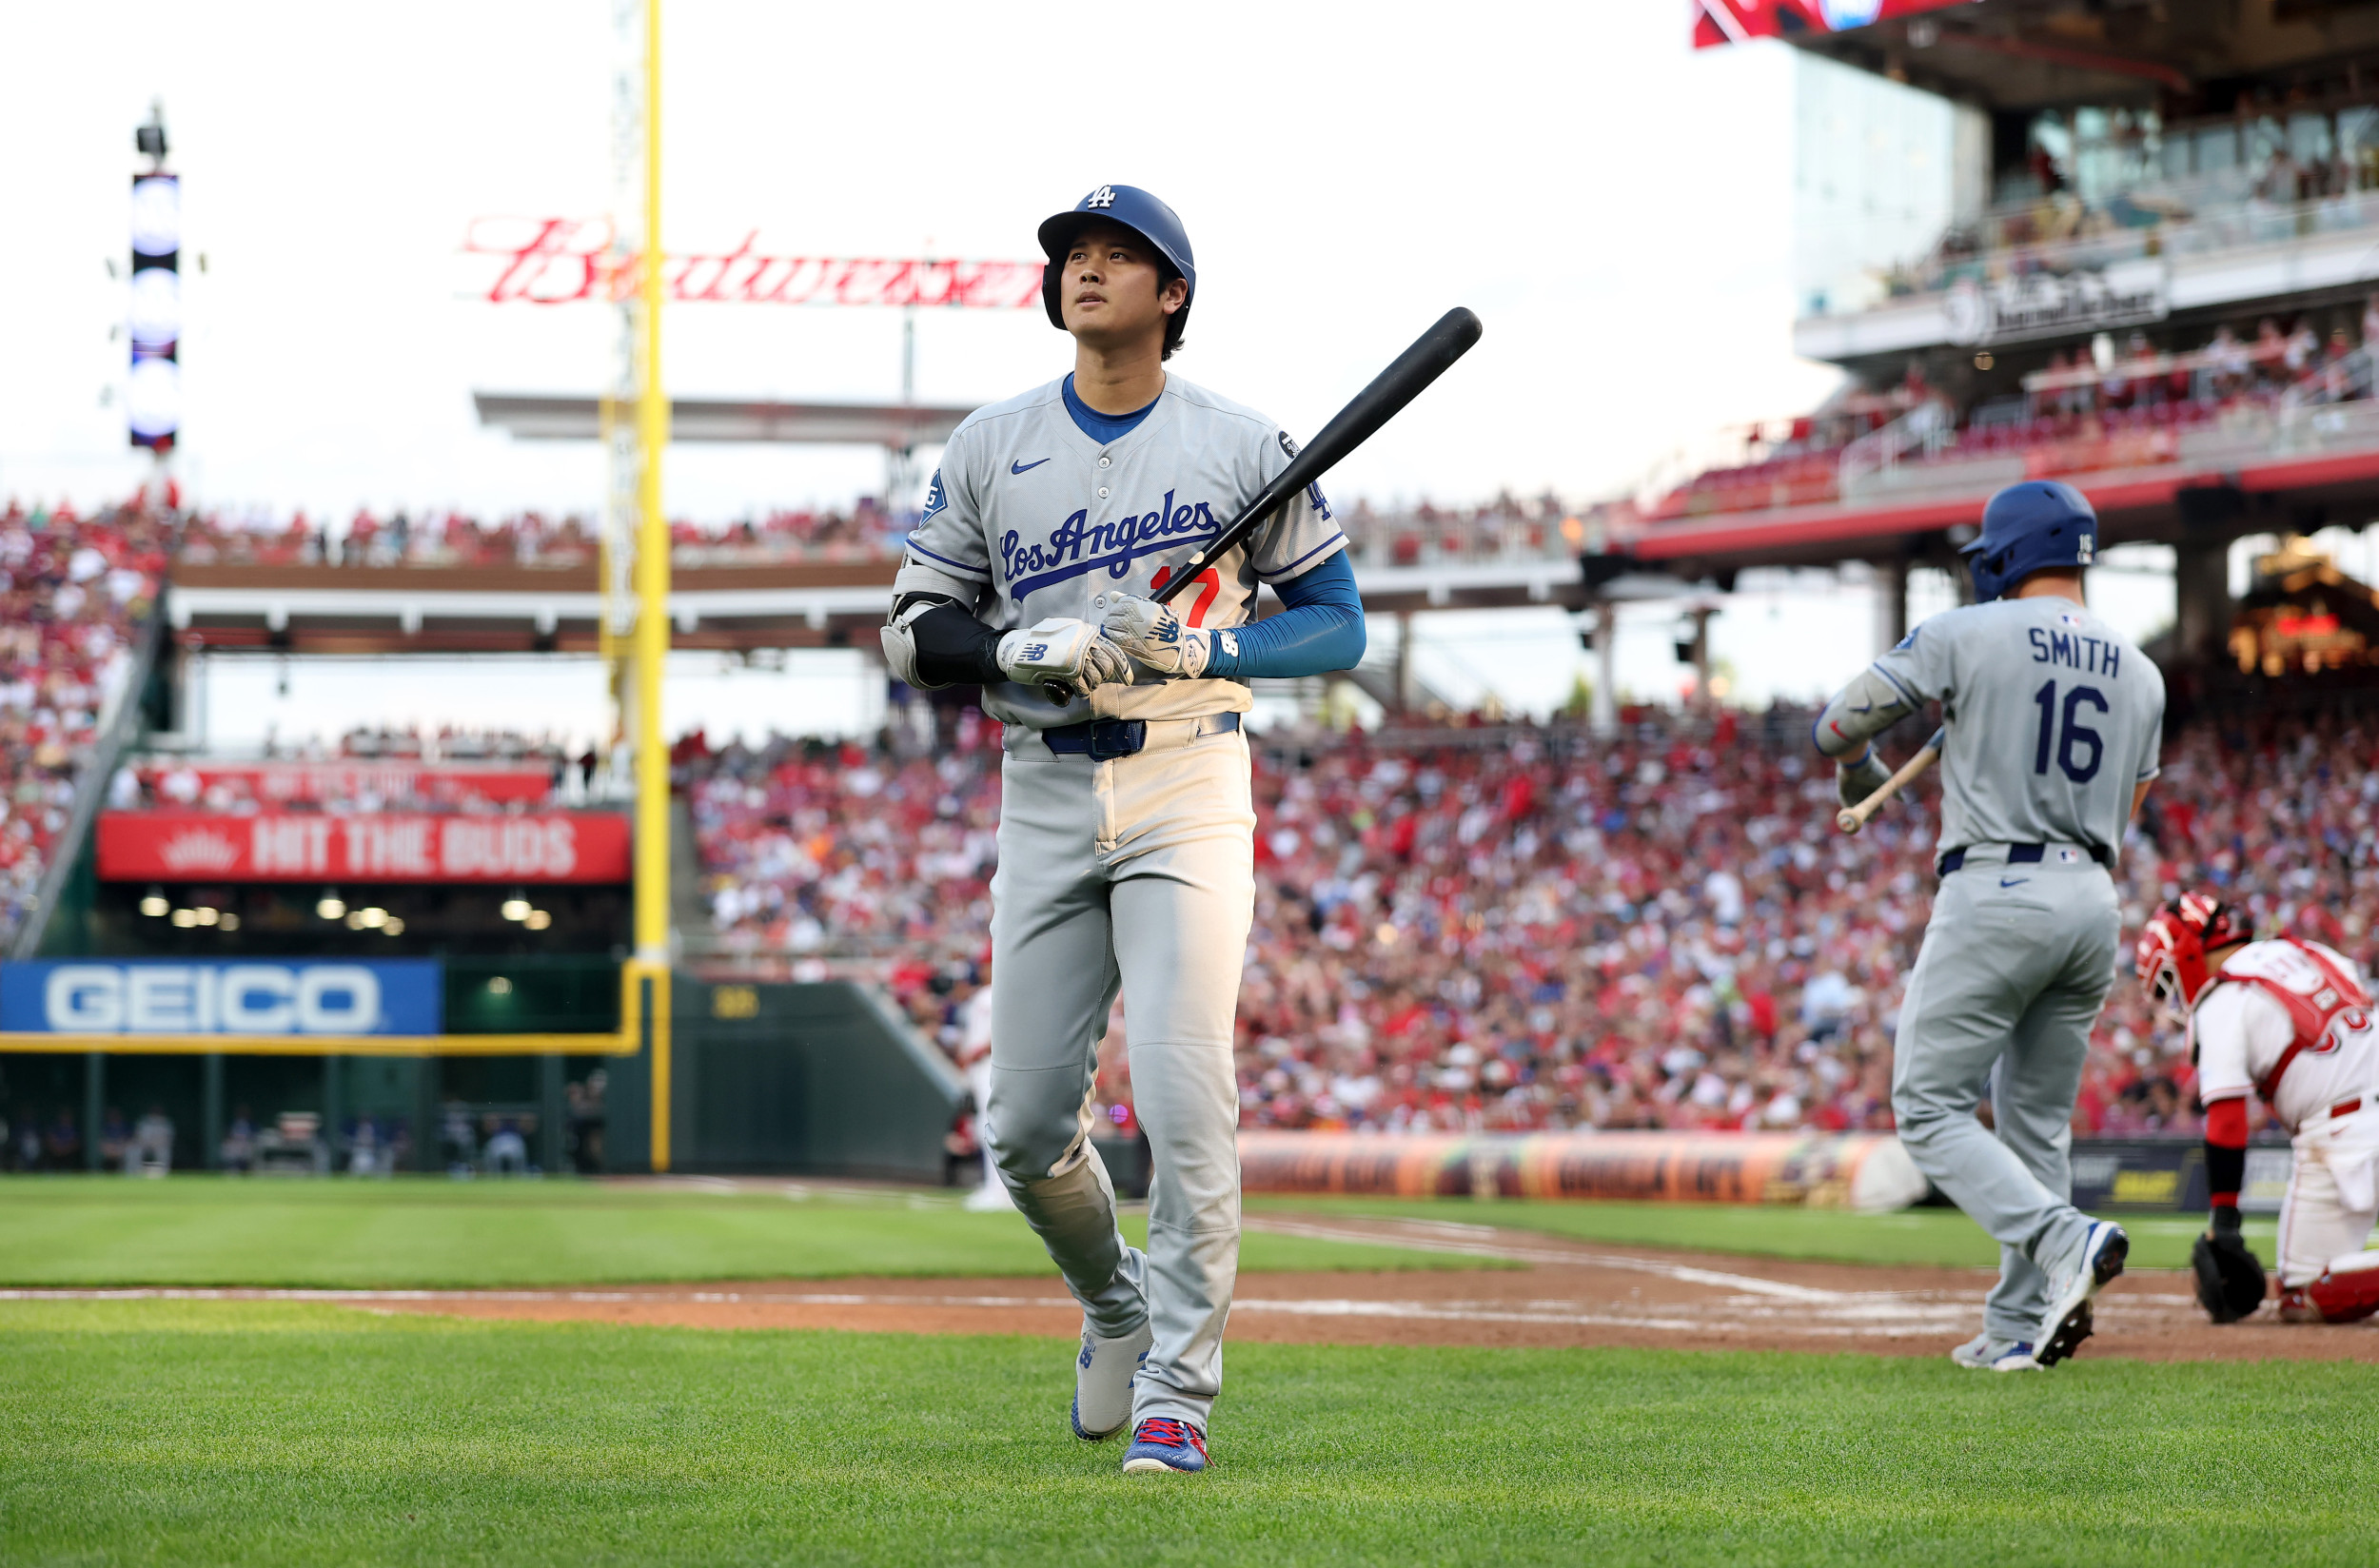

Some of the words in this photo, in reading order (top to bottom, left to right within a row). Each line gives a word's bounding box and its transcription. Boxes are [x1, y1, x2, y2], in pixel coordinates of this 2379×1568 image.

[1088, 186, 1116, 209] LA
[1000, 530, 1045, 582] Los
[1046, 488, 1222, 579] Angeles
[2079, 534, 2093, 552] 16
[2029, 628, 2120, 678] SMITH
[2035, 678, 2110, 785] 16
[252, 820, 330, 874] HIT
[344, 820, 438, 875] THE
[442, 819, 578, 877] BUDS
[45, 966, 383, 1032] GEICO
